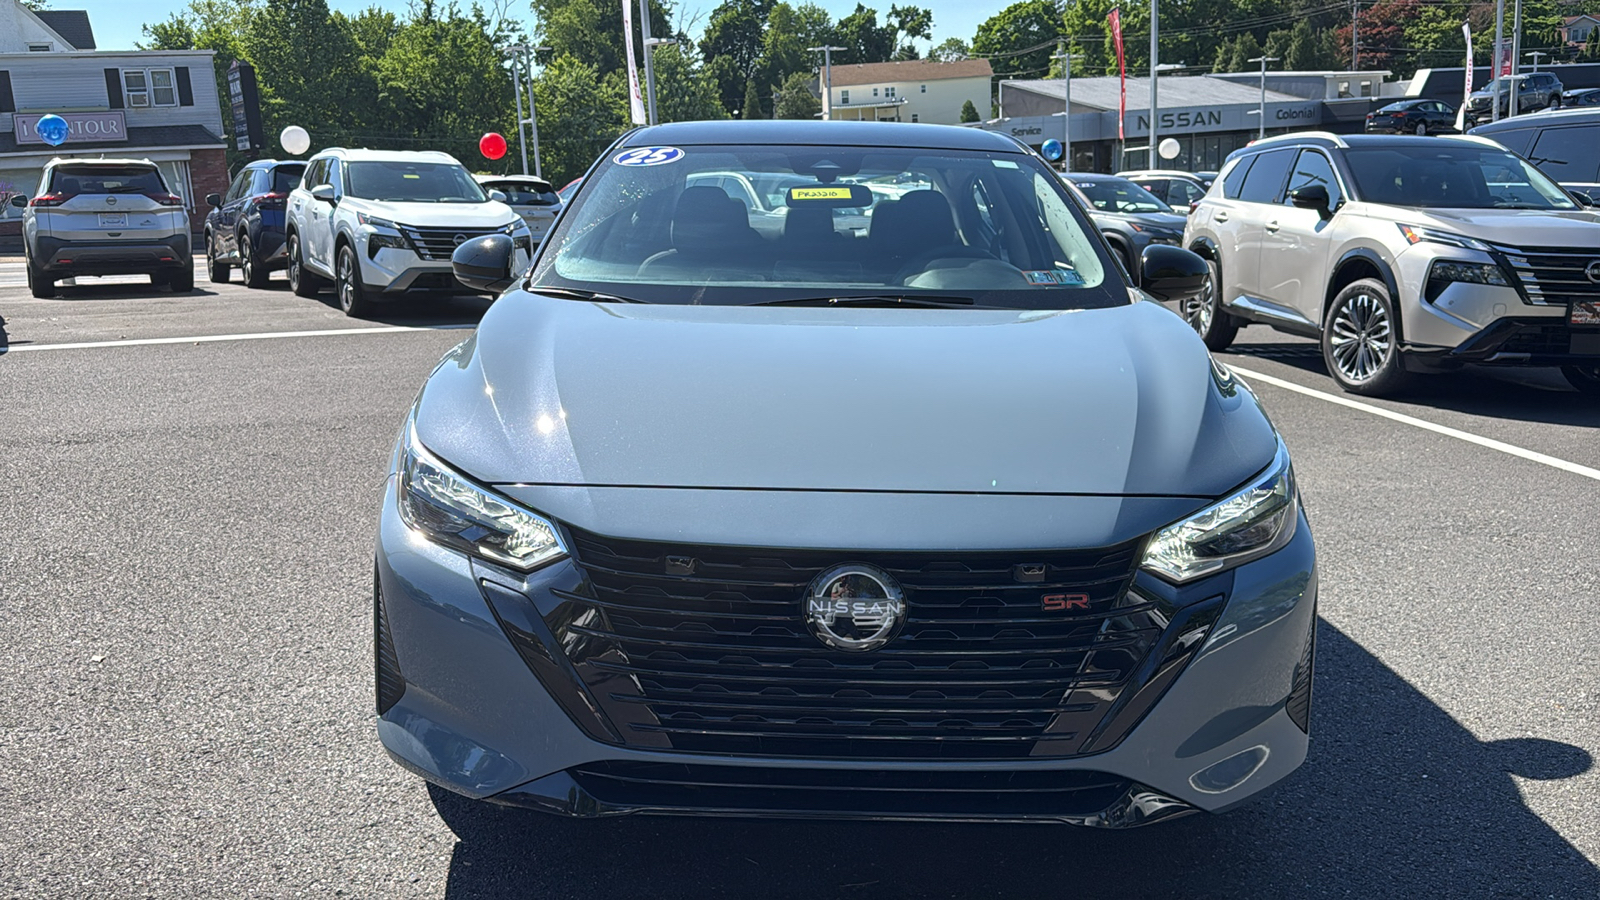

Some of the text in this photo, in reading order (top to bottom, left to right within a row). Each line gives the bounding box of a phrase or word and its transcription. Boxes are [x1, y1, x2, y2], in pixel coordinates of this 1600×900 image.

[1275, 107, 1316, 121] Colonial
[1011, 126, 1042, 137] Service
[620, 148, 676, 165] 25
[809, 599, 901, 615] NISSAN
[1043, 594, 1089, 610] SR
